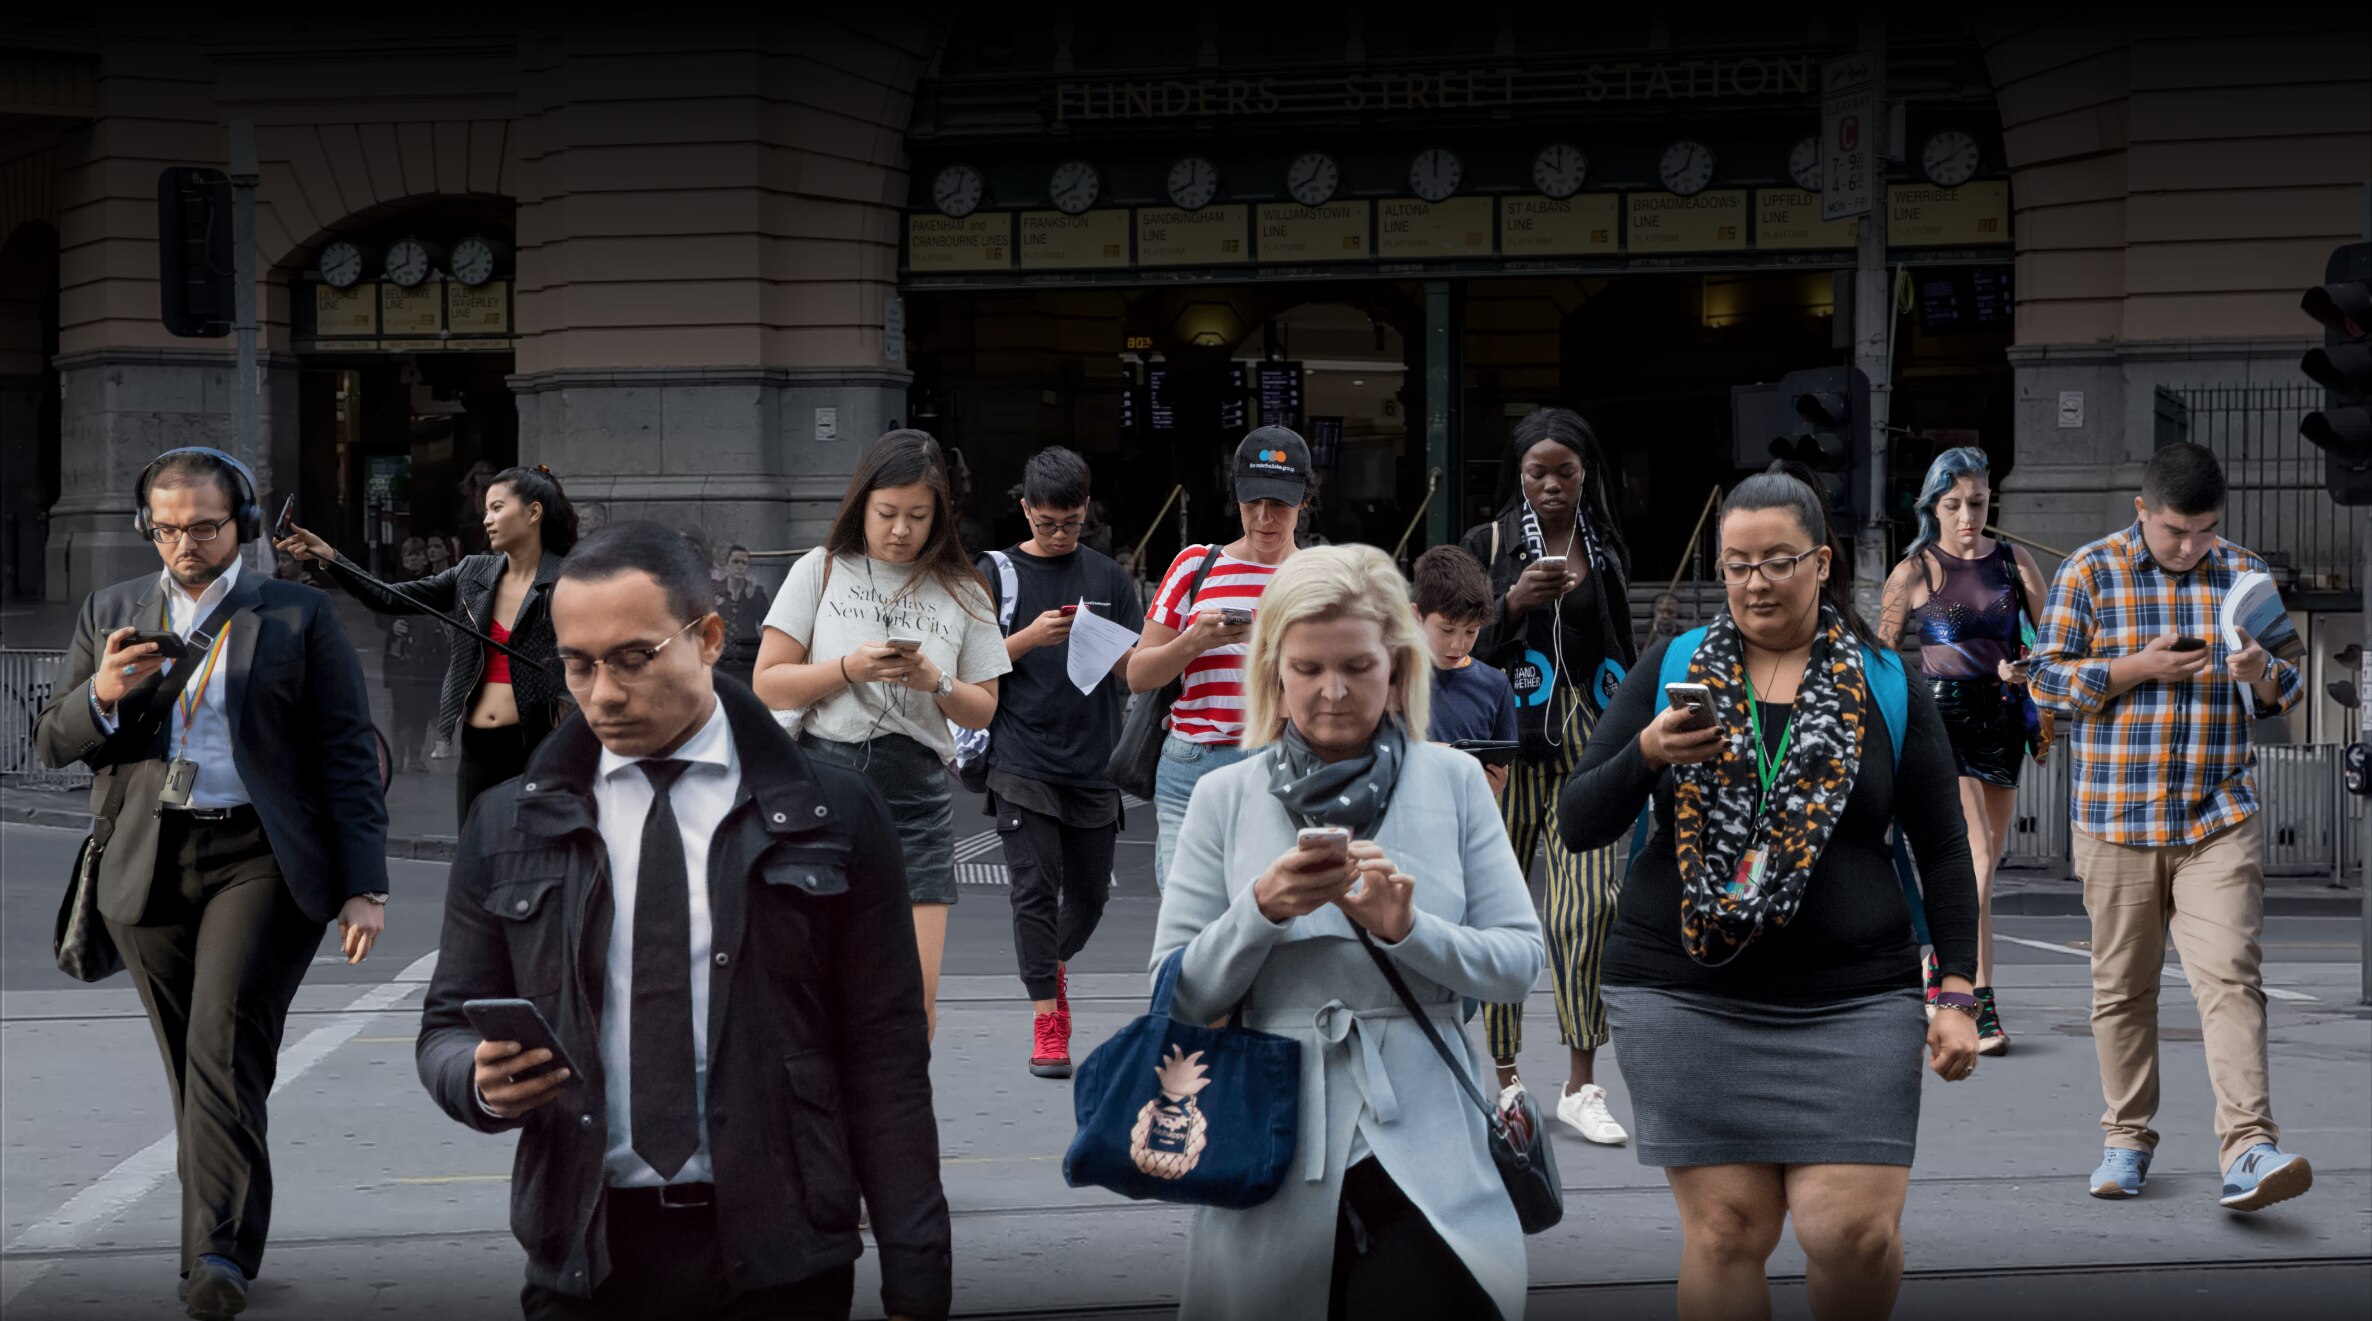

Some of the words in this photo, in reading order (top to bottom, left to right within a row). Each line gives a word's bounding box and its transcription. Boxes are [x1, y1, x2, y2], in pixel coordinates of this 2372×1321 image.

[1055, 78, 1281, 121] FLINDERS
[1343, 67, 1521, 112] STREET
[1584, 54, 1809, 103] STATION
[1762, 193, 1814, 207] UPFIELD
[1894, 189, 1959, 203] WERRIBEE
[1384, 203, 1430, 217] ALTONA
[1507, 201, 1523, 215] ST
[1525, 200, 1572, 214] ALBANS
[1633, 196, 1738, 212] BROADMEADOWS
[1828, 200, 1846, 212] MON
[1142, 211, 1225, 226] SANDRINGHAM
[1262, 206, 1351, 221] WILLIAMSTOWN
[1762, 211, 1790, 224] LINE
[1894, 208, 1921, 221] LINE
[911, 219, 965, 232] PAKENHAM
[968, 220, 987, 232] and
[1023, 216, 1089, 230] FRANKSTON
[1384, 221, 1409, 233] LINE
[1507, 219, 1534, 231] LINE
[1633, 216, 1661, 228] LINE
[1143, 230, 1168, 241] LINE
[1263, 225, 1289, 237] LINE
[911, 234, 978, 249] CRANBOURNE
[981, 233, 1010, 248] LINES
[1023, 233, 1048, 246] LINE
[450, 287, 475, 299] GLEN
[319, 300, 339, 311] LINE
[384, 300, 405, 311] LINE
[450, 299, 499, 309] WAVERLEY
[450, 309, 472, 319] LINE
[828, 601, 866, 620] New
[916, 615, 953, 640] City
